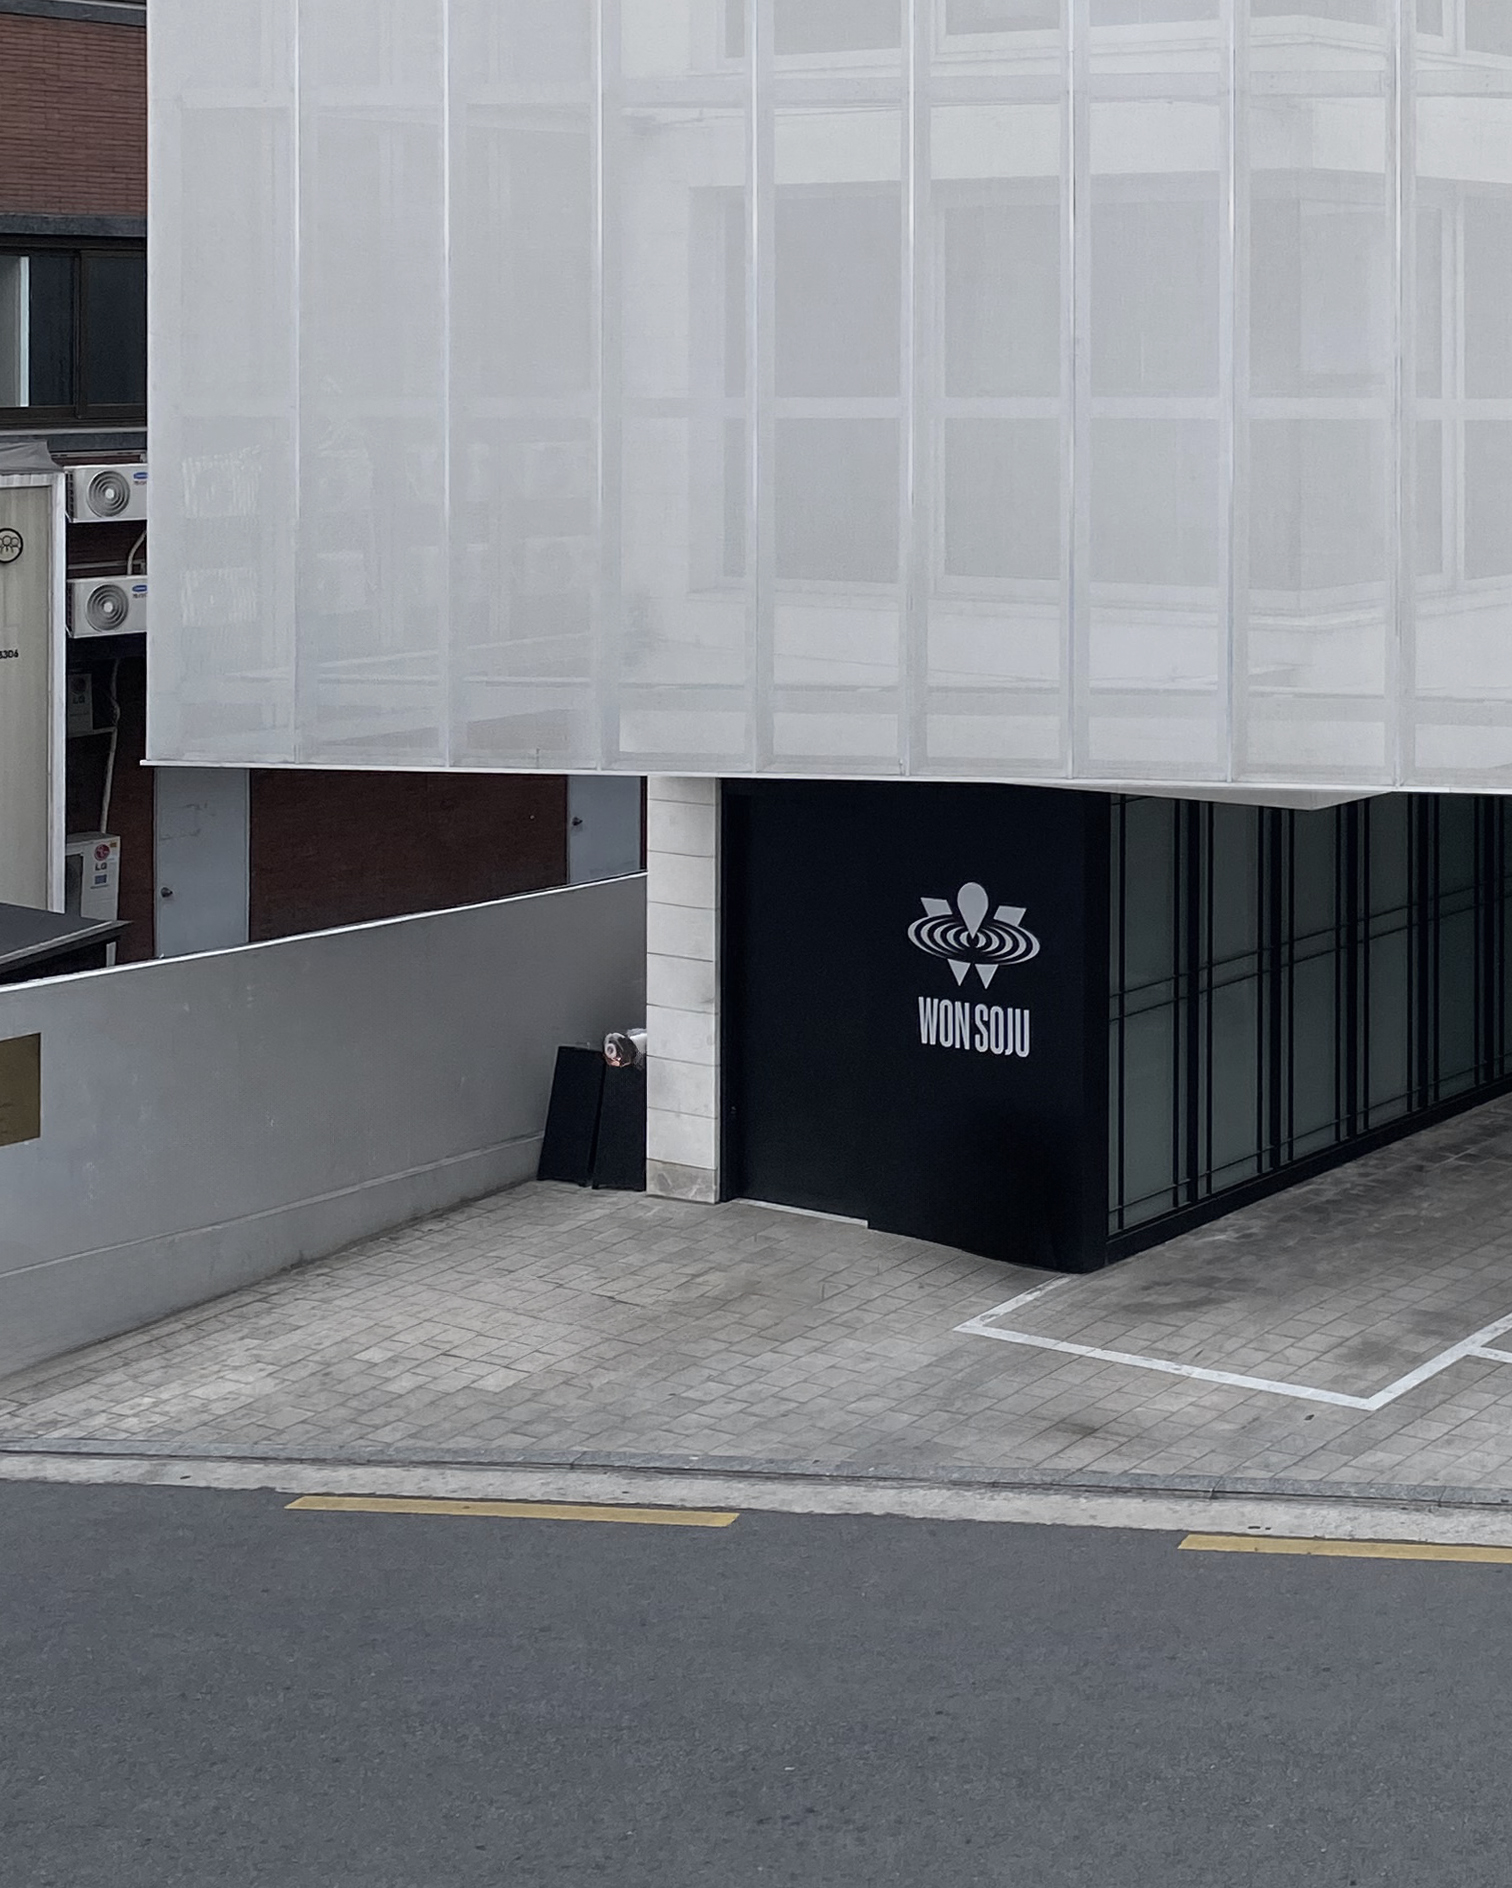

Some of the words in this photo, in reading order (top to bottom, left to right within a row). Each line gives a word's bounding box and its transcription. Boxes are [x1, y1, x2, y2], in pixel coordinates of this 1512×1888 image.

[72, 694, 86, 705] LG
[95, 862, 108, 871] LG
[918, 996, 970, 1050] WON
[974, 1003, 1030, 1058] SOJU
